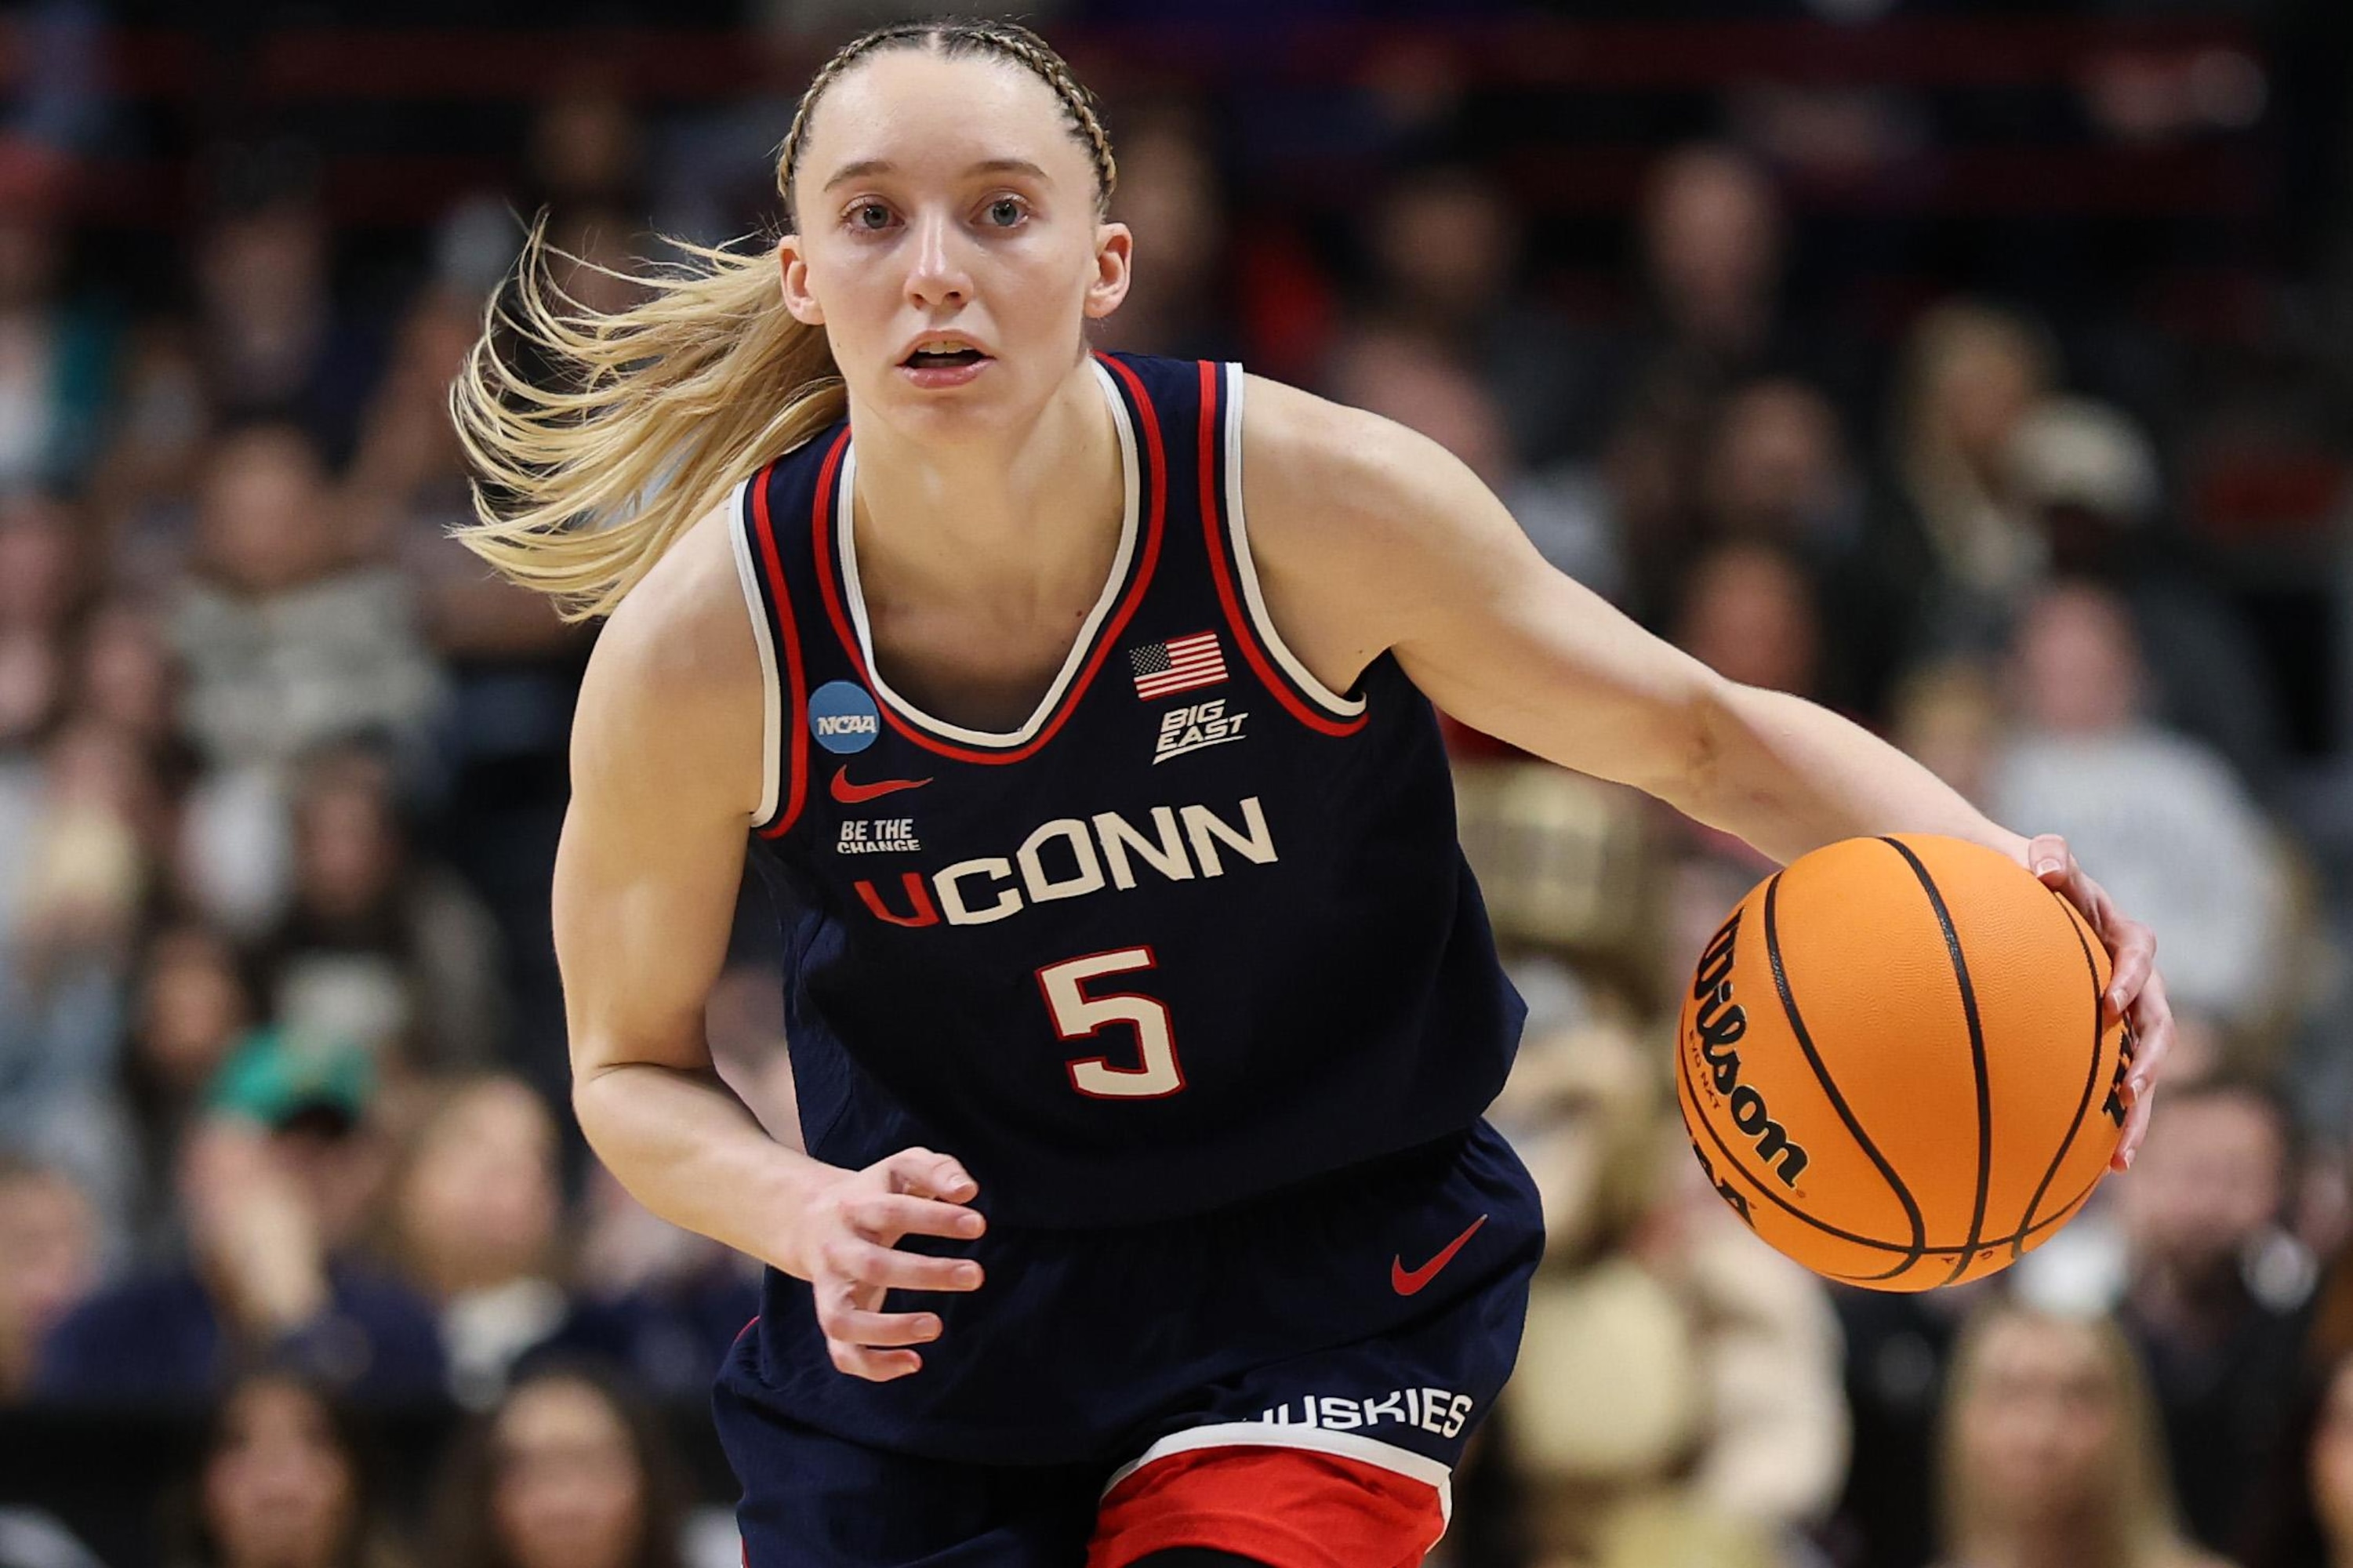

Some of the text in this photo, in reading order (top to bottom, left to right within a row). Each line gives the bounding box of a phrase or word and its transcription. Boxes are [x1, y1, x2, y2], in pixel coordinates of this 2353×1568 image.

[817, 715, 877, 735] NCAA
[1156, 712, 1249, 753] EAST
[1160, 699, 1226, 733] BIG
[837, 839, 922, 855] CHANGE
[841, 818, 914, 841] BE THE
[853, 797, 1279, 927] UCONN
[1033, 945, 1189, 1100] 5
[1694, 906, 1810, 1190] Wilson
[1262, 1388, 1474, 1439] USKIES
